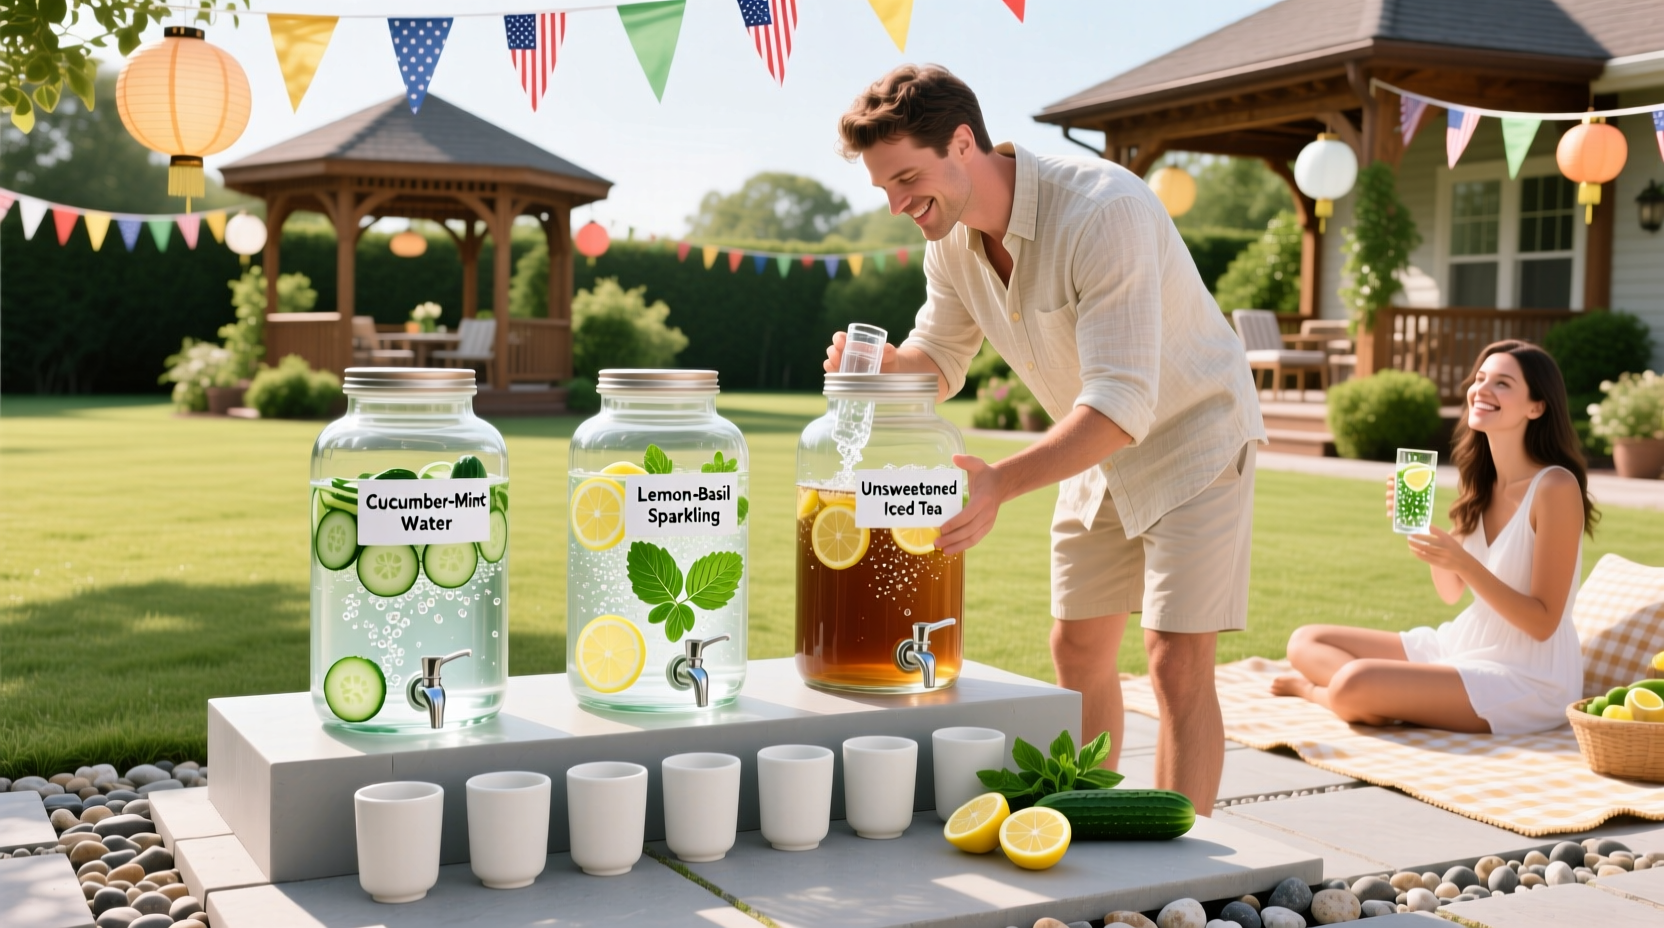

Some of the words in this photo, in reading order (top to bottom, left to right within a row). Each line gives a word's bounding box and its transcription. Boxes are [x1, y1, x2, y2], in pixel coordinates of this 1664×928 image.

[366, 492, 487, 510] Cucumber-Mint
[637, 485, 730, 502] Lemon-Basil
[884, 500, 914, 516] Iced
[918, 501, 942, 515] Tea
[401, 516, 453, 531] Water
[648, 507, 720, 527] Sparkling
